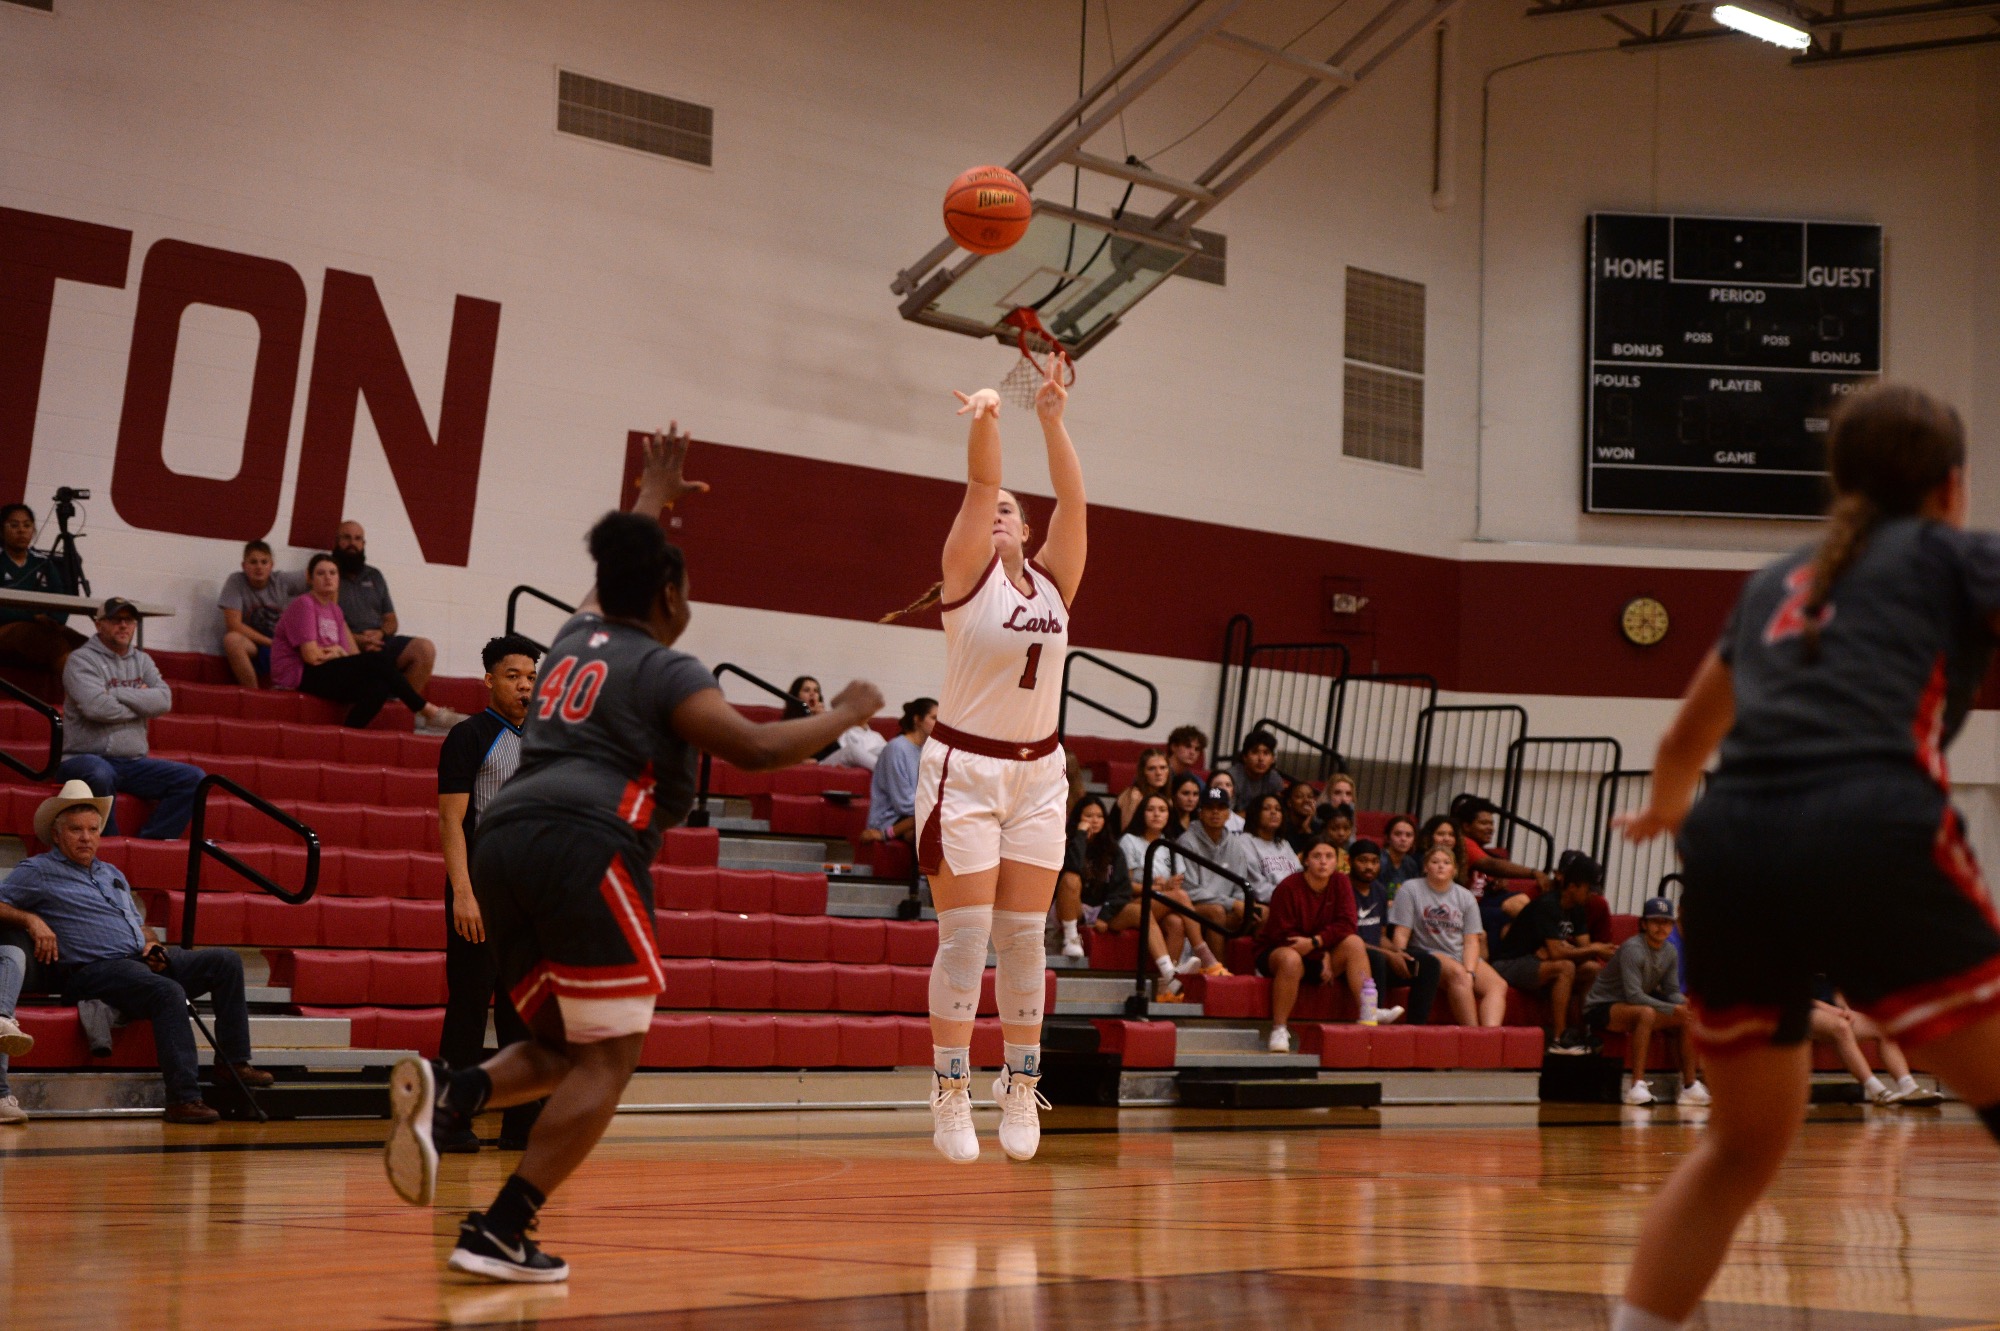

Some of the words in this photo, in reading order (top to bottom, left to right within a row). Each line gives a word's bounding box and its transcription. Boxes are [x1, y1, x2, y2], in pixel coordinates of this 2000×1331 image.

[1604, 258, 1664, 279] HOME
[1808, 265, 1874, 288] GUEST
[1710, 287, 1766, 304] PERIOD
[1685, 331, 1713, 344] POSS
[1762, 334, 1790, 347] POSS
[1612, 342, 1663, 357] BONUS
[1810, 350, 1861, 365] BONUS
[1594, 373, 1641, 388] FOULS
[1709, 378, 1762, 392] PLAYER
[1597, 446, 1635, 460] WON
[1714, 450, 1757, 465] GAME
[1003, 605, 1062, 634] Larks
[1018, 642, 1043, 690] 1
[538, 655, 609, 724] 40
